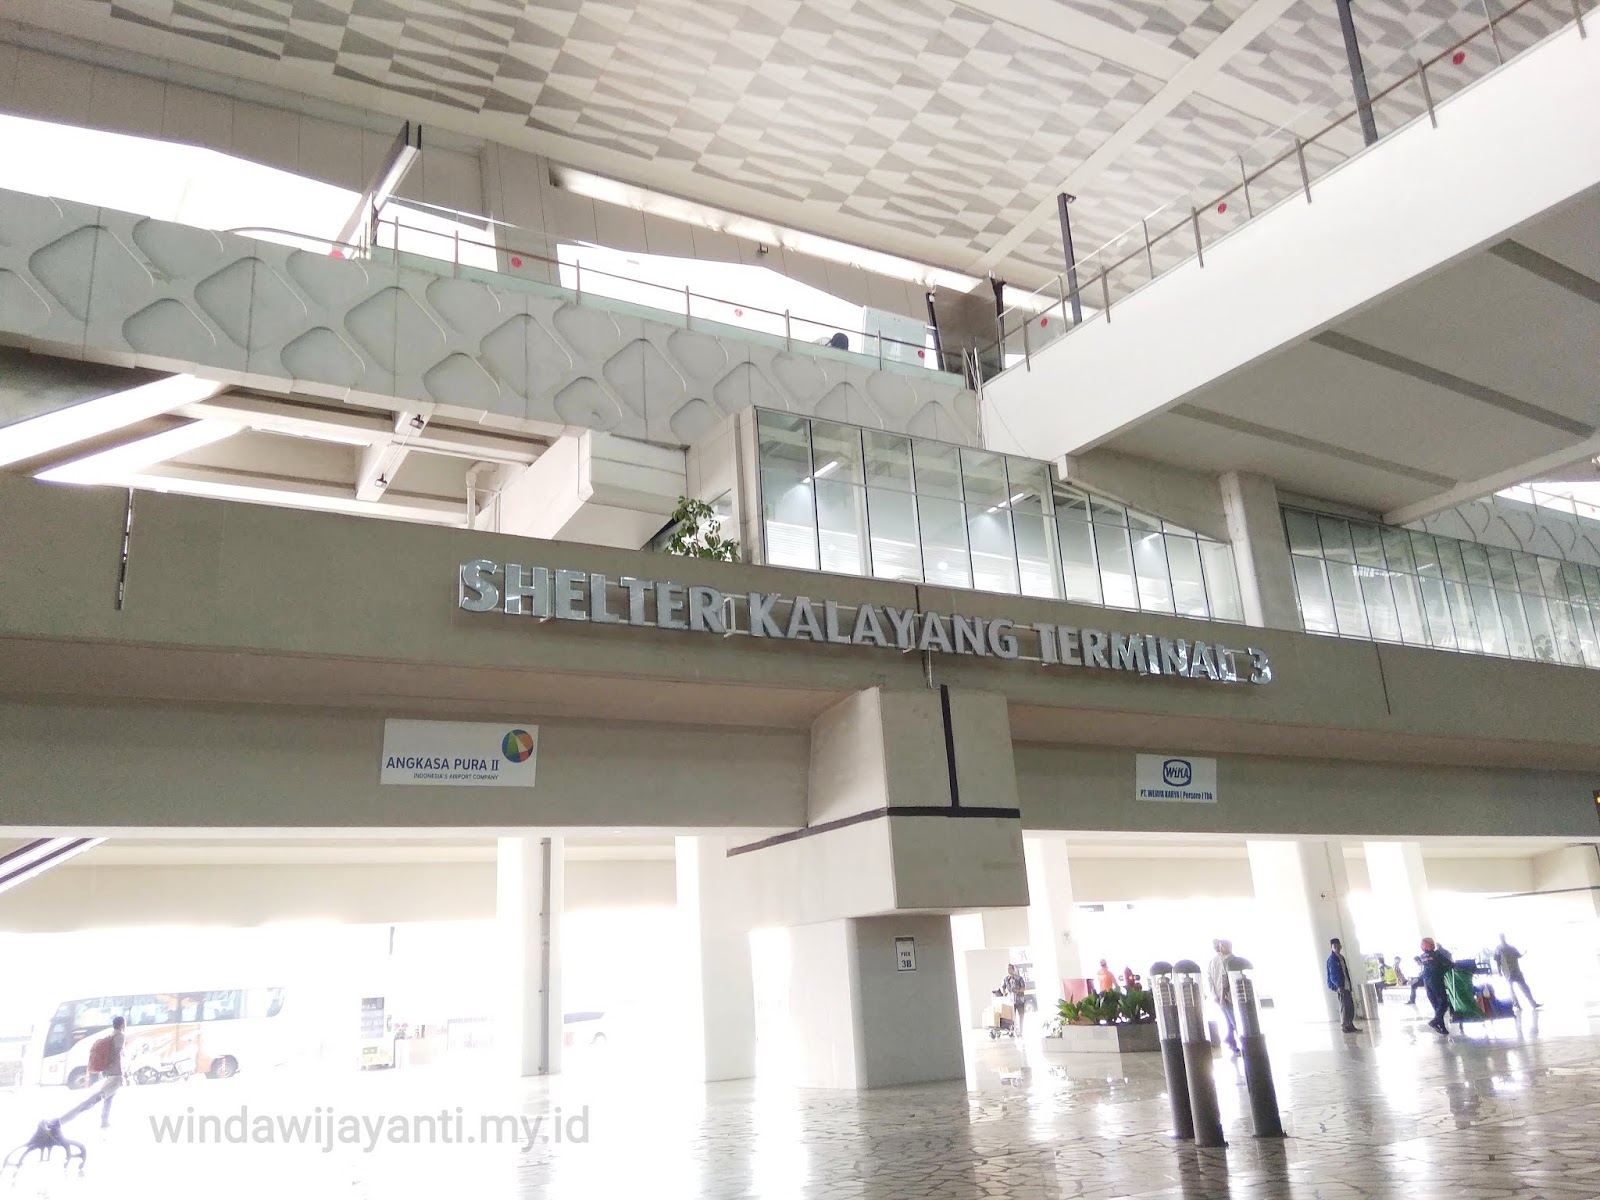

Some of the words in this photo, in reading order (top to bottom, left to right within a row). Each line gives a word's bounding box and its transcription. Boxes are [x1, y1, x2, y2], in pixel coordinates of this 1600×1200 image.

[461, 558, 727, 634] SHELTER
[746, 591, 1019, 660] KALAYANG
[1032, 622, 1237, 683] TERMINAL
[1246, 646, 1273, 685] 3
[386, 757, 450, 770] ANGKASA
[454, 758, 488, 771] PURA
[491, 759, 500, 772] II
[473, 773, 499, 781] COMPANY
[901, 960, 912, 968] 3B
